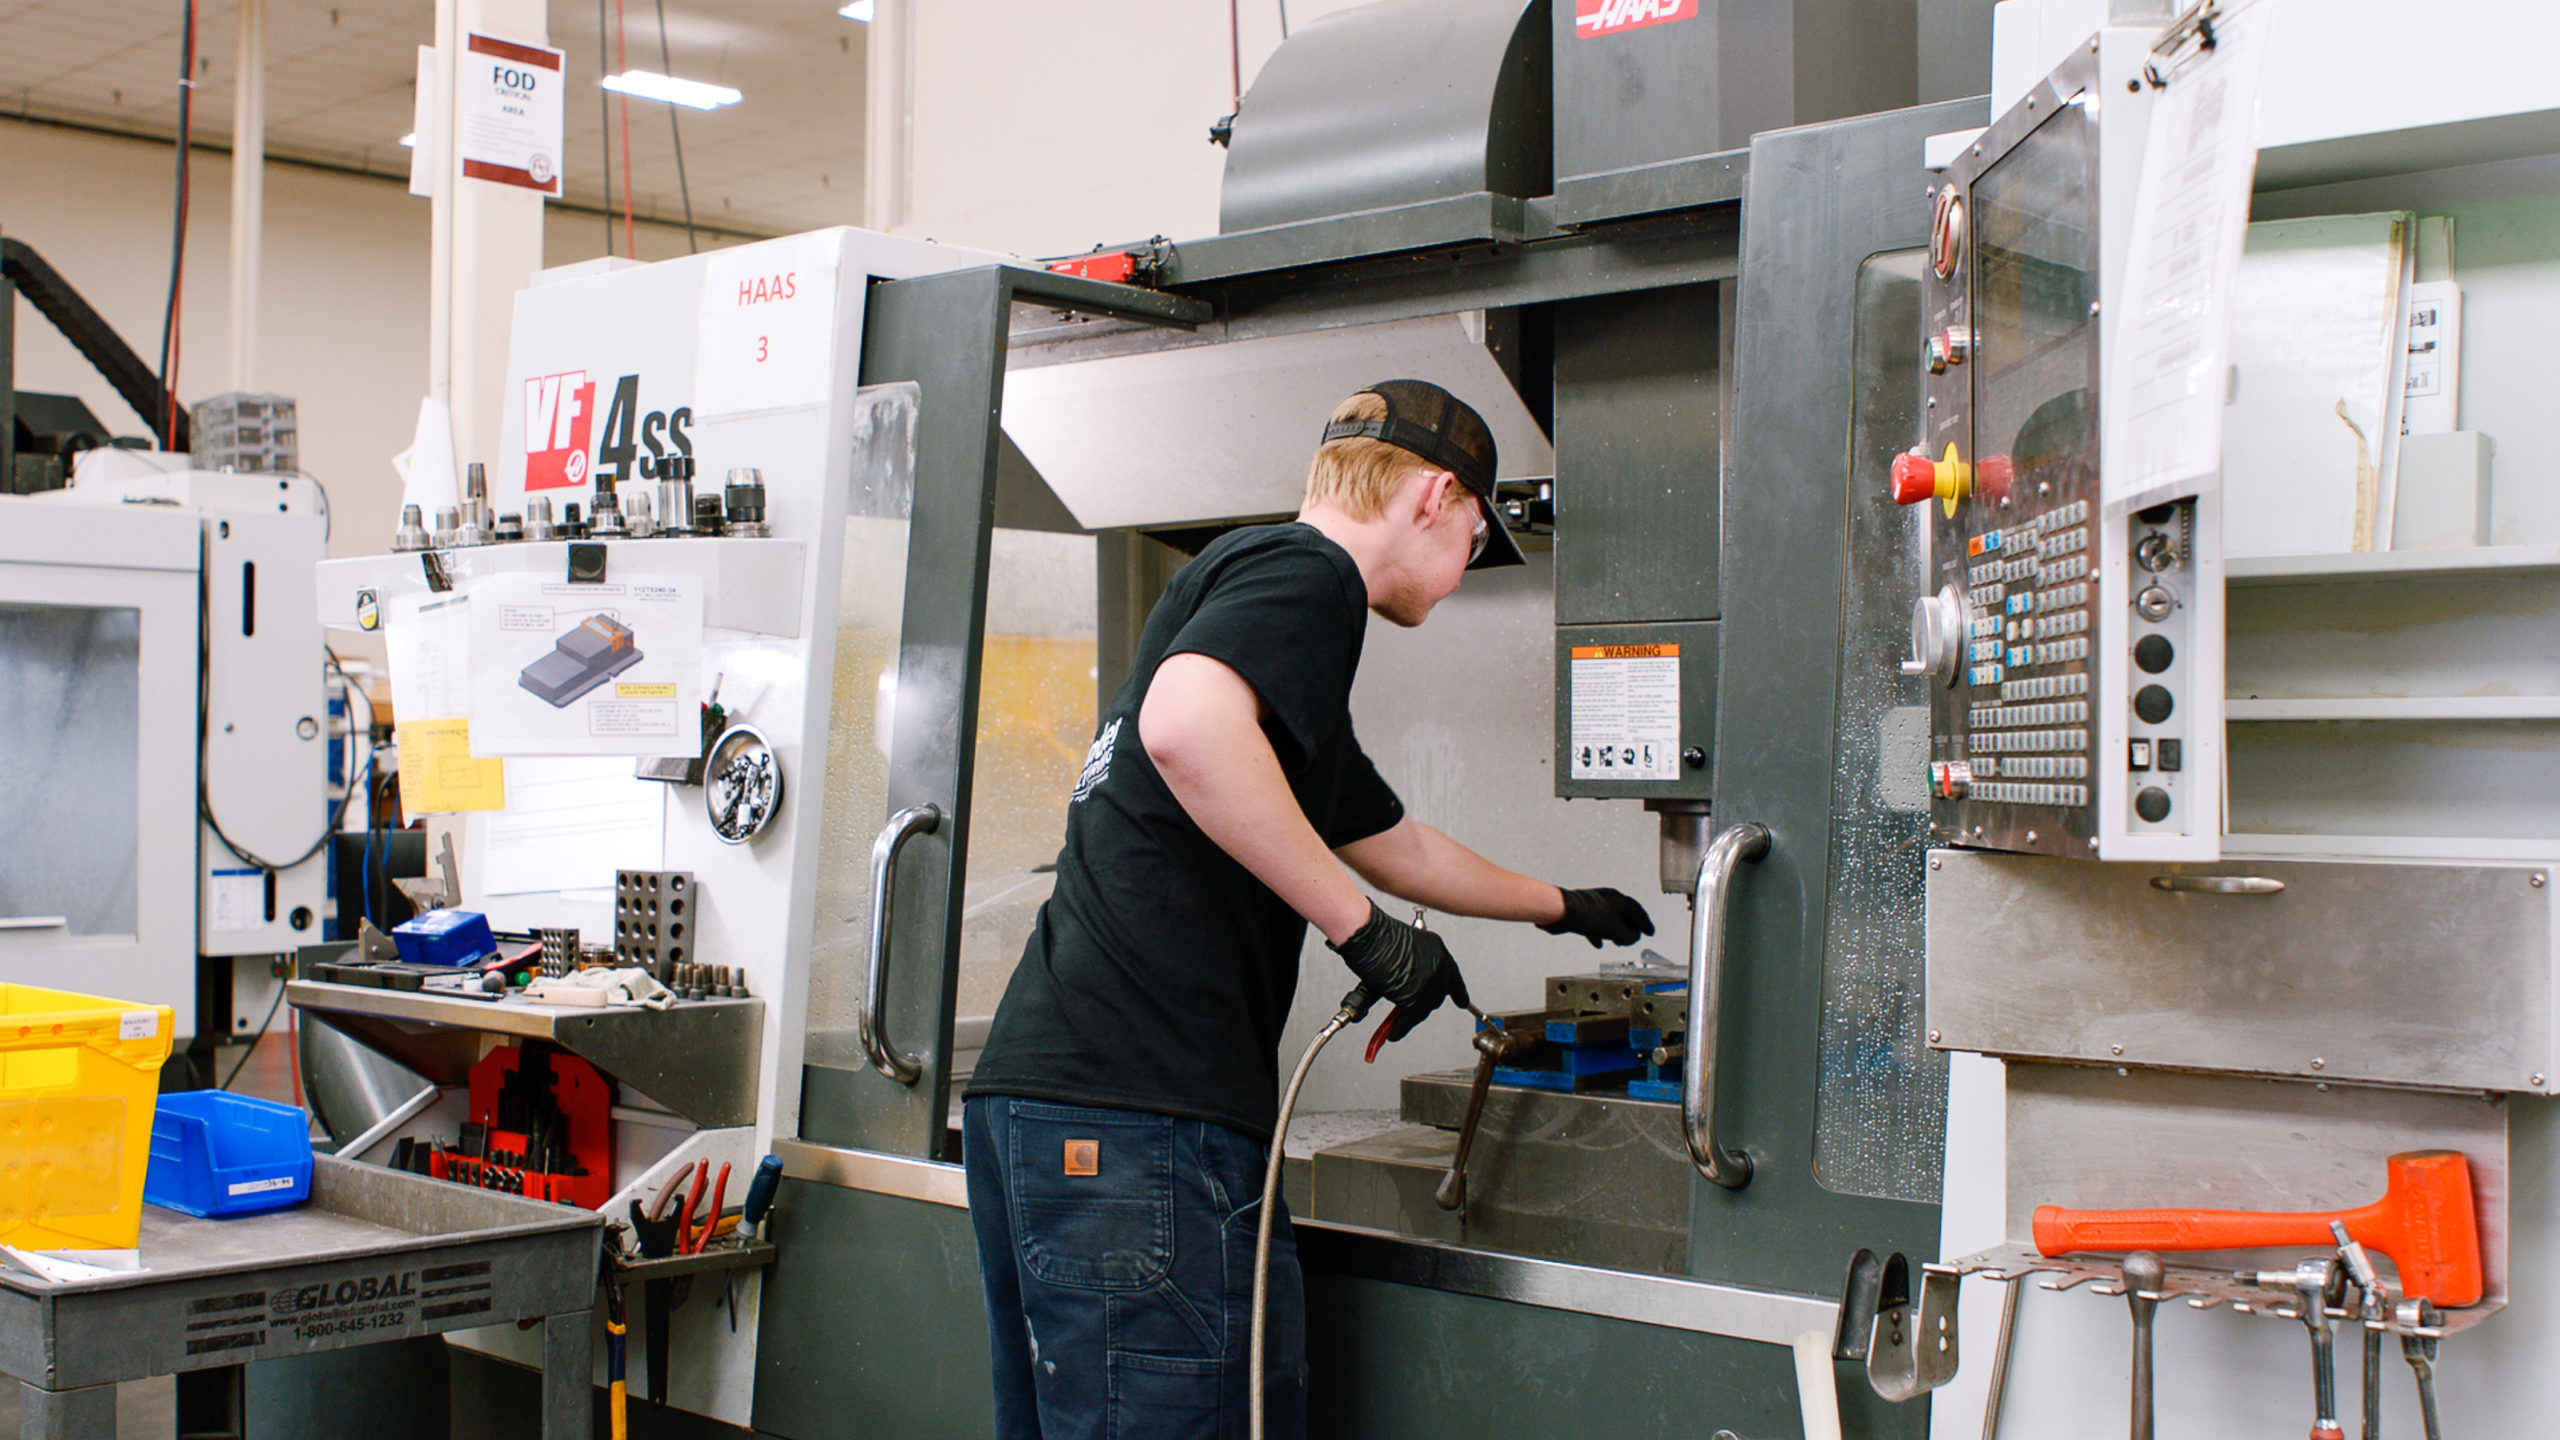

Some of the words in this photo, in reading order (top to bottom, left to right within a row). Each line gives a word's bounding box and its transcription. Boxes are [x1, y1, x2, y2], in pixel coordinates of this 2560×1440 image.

[494, 66, 535, 90] FOD
[503, 105, 525, 115] AREA
[738, 272, 796, 307] HAAS
[756, 336, 769, 363] 3
[524, 369, 587, 454] VF
[1604, 645, 1661, 657] WARNING
[297, 1272, 415, 1310] GLOBAL
[269, 1299, 415, 1327] www.globalindustrial.com
[295, 1312, 404, 1339] 1-800-645-1232
